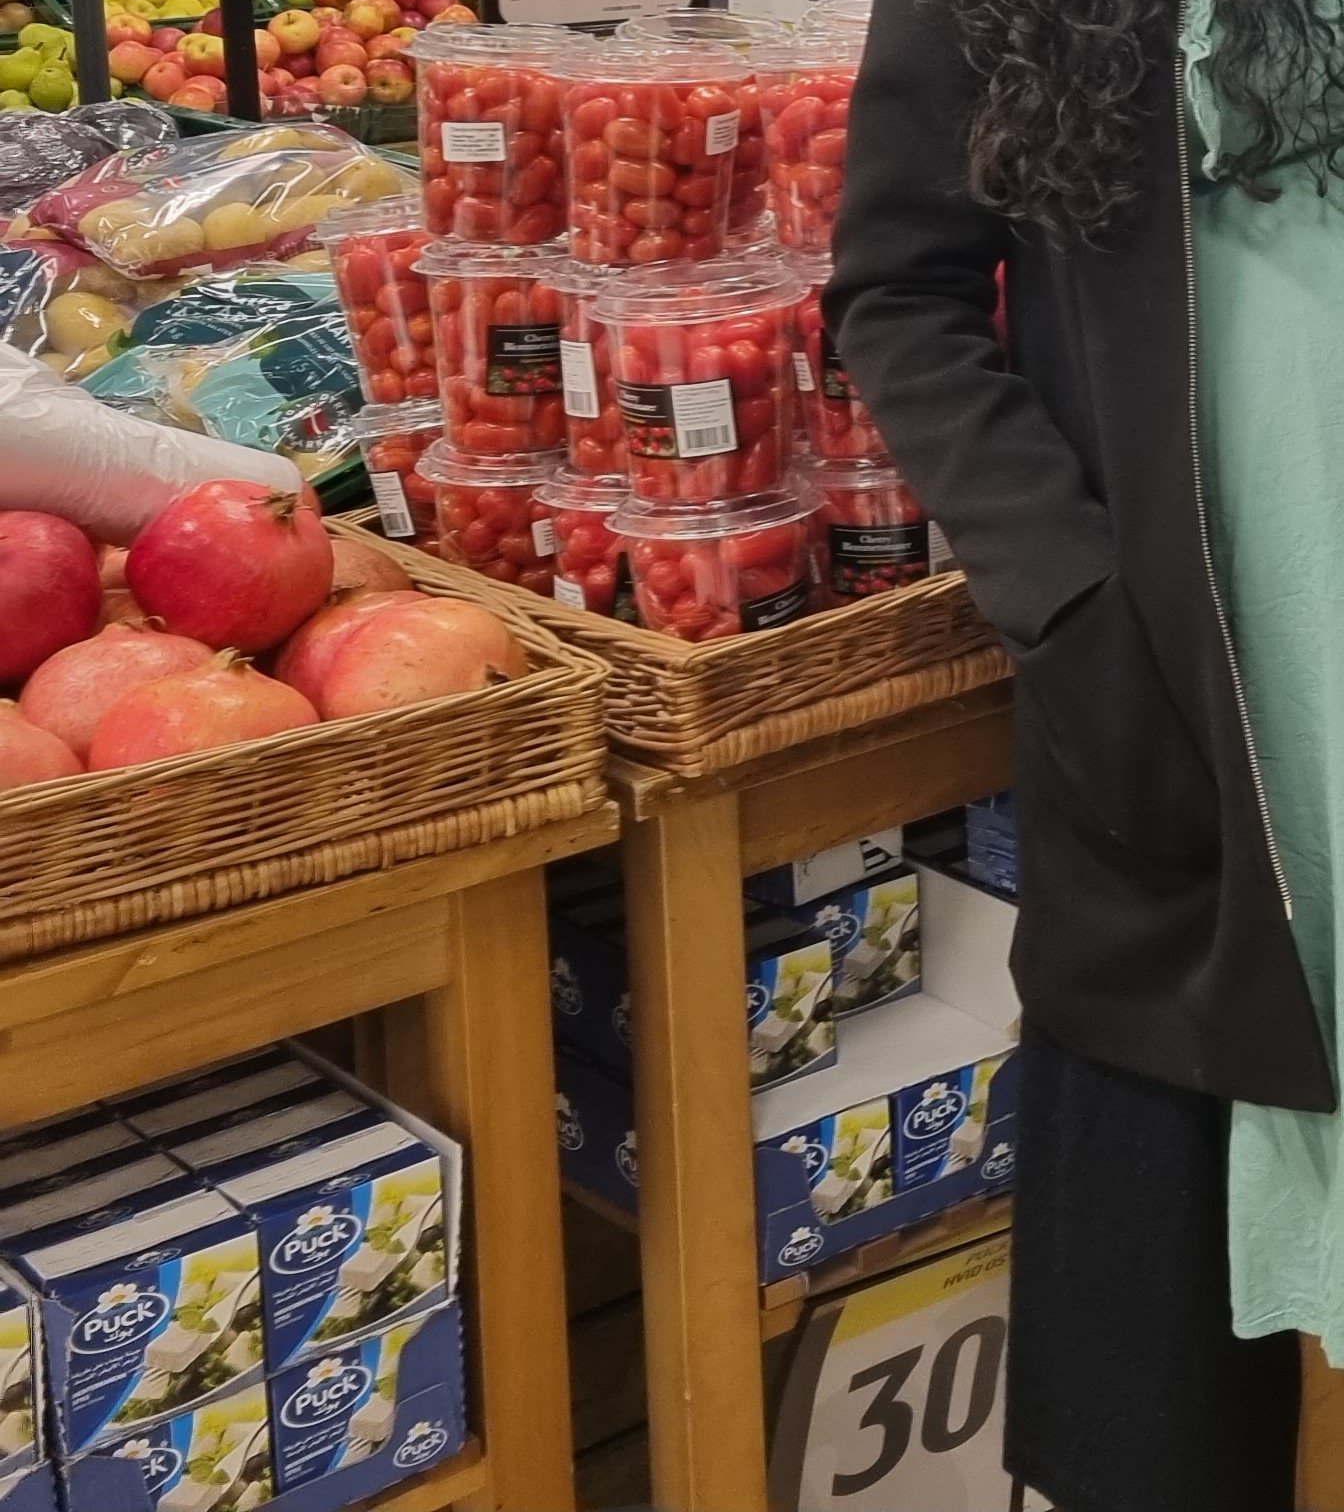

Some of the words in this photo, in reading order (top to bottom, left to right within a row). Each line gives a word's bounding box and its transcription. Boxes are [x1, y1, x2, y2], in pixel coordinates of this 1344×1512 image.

[912, 1098, 959, 1130] Puck
[284, 1222, 350, 1262] Puck
[783, 1237, 818, 1260] Puck
[83, 1301, 157, 1342] Puck
[294, 1372, 360, 1416] Puck
[831, 1313, 1007, 1497] 30
[400, 1432, 442, 1462] Puck
